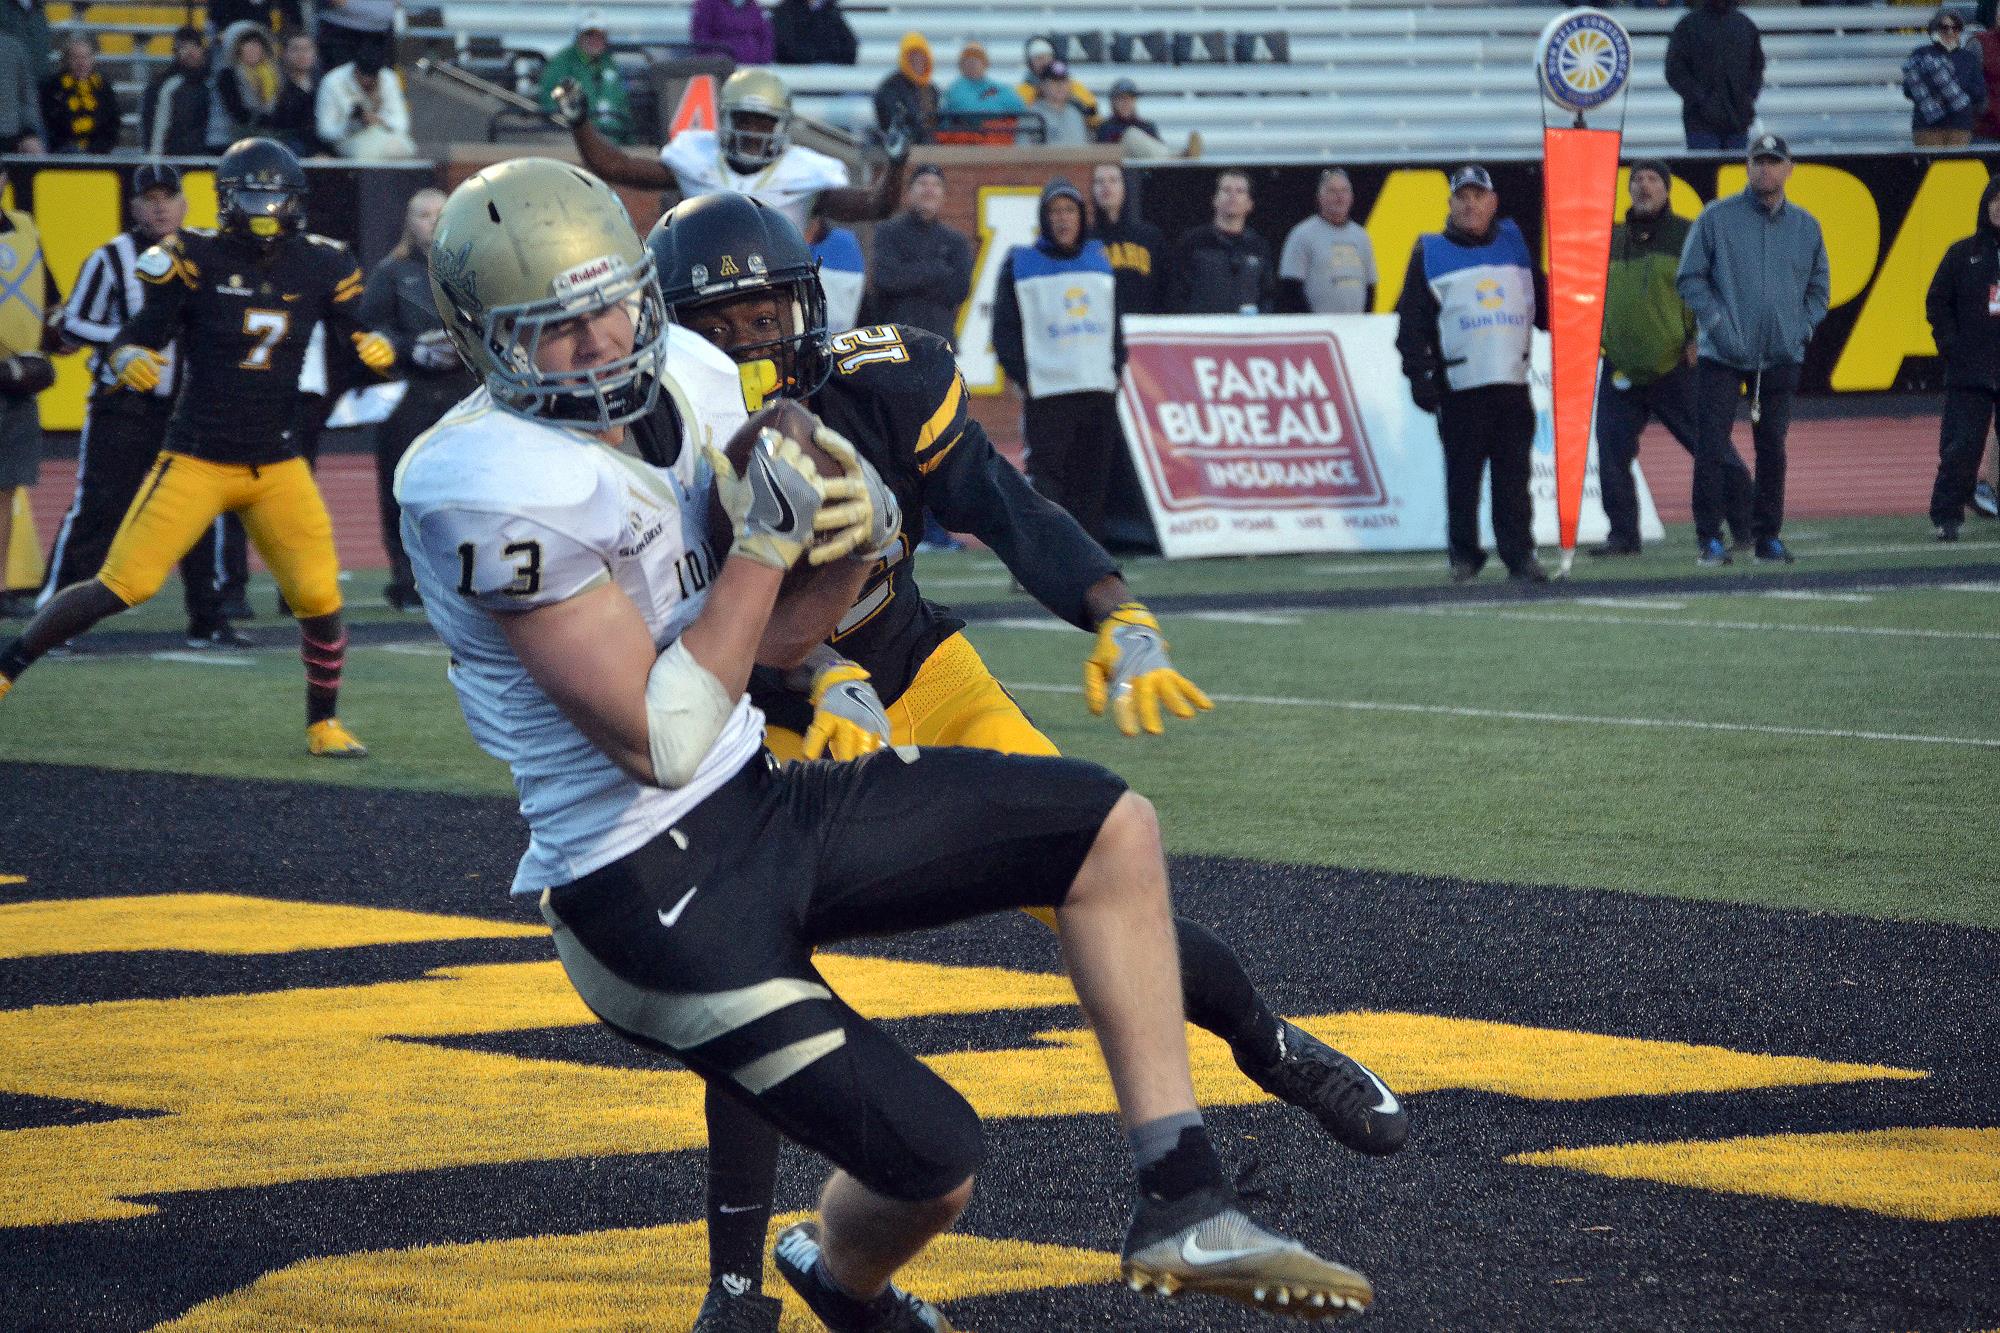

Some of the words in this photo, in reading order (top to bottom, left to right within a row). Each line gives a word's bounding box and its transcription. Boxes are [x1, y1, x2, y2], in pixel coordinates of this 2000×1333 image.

[568, 260, 609, 285] Riddell
[719, 254, 740, 277] A
[239, 308, 290, 370] 7
[831, 323, 911, 375] 12
[1193, 356, 1330, 400] FARM
[1156, 402, 1343, 446] BUREAU
[1204, 460, 1359, 488] INSURANCE
[1168, 516, 1220, 535] AUTO
[457, 539, 543, 598] 13
